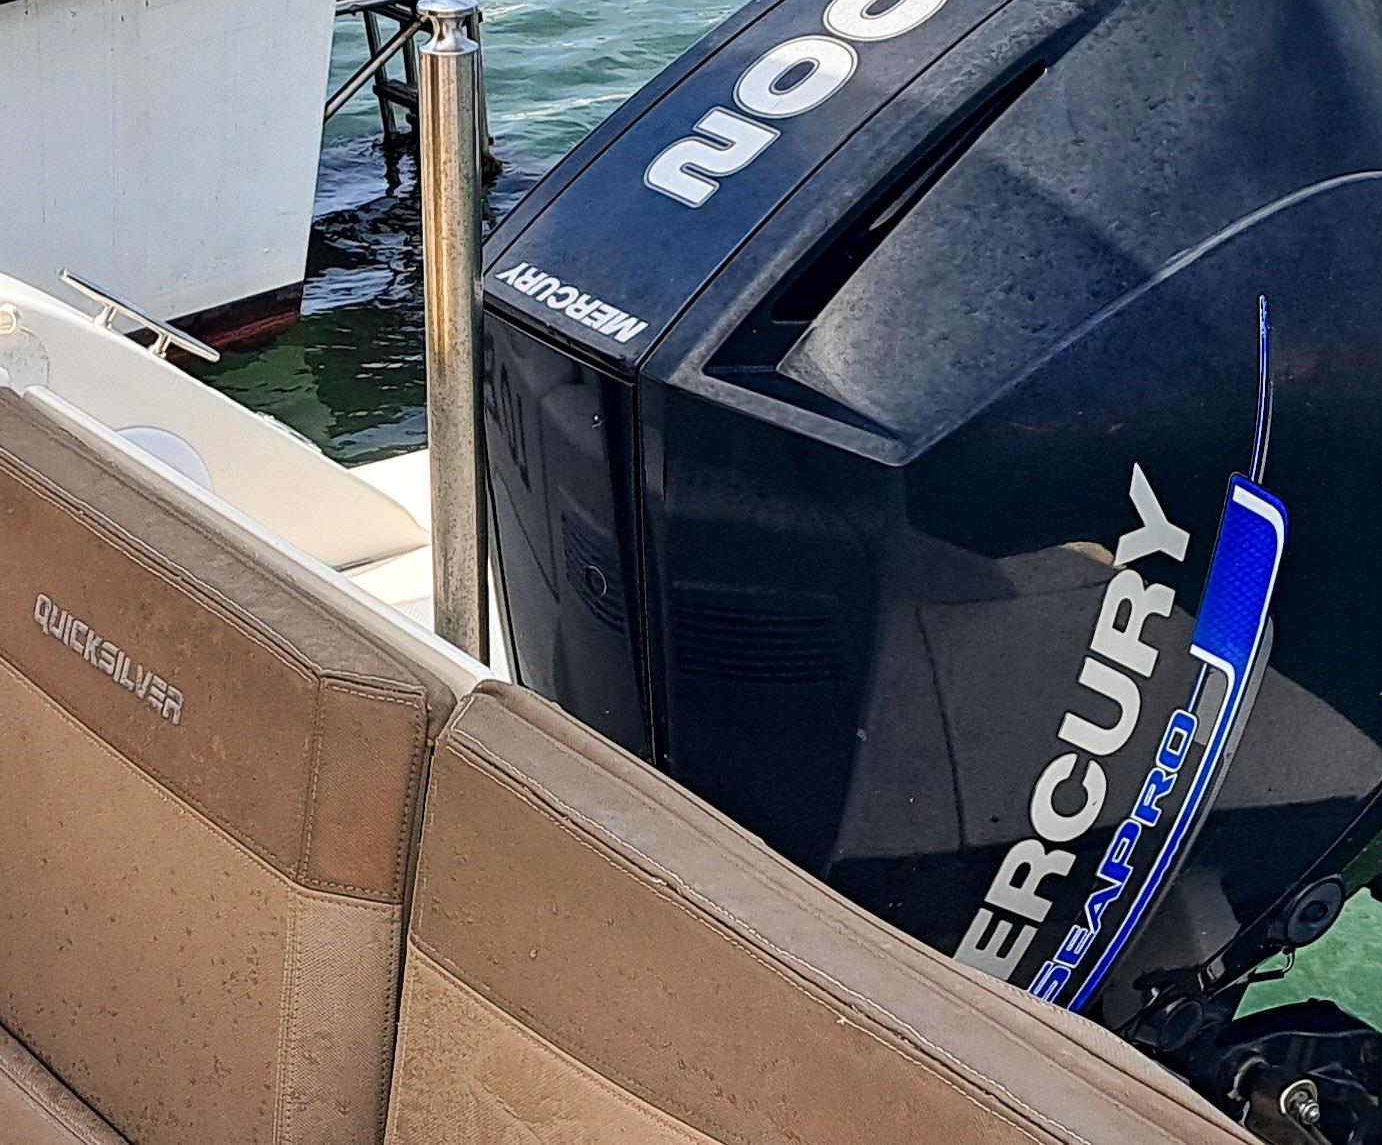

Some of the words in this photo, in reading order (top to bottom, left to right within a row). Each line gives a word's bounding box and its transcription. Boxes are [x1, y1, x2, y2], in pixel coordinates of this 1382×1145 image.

[494, 261, 650, 344] MERCURY
[33, 592, 185, 726] QUICKSILVER
[953, 461, 1191, 982] ERCURY
